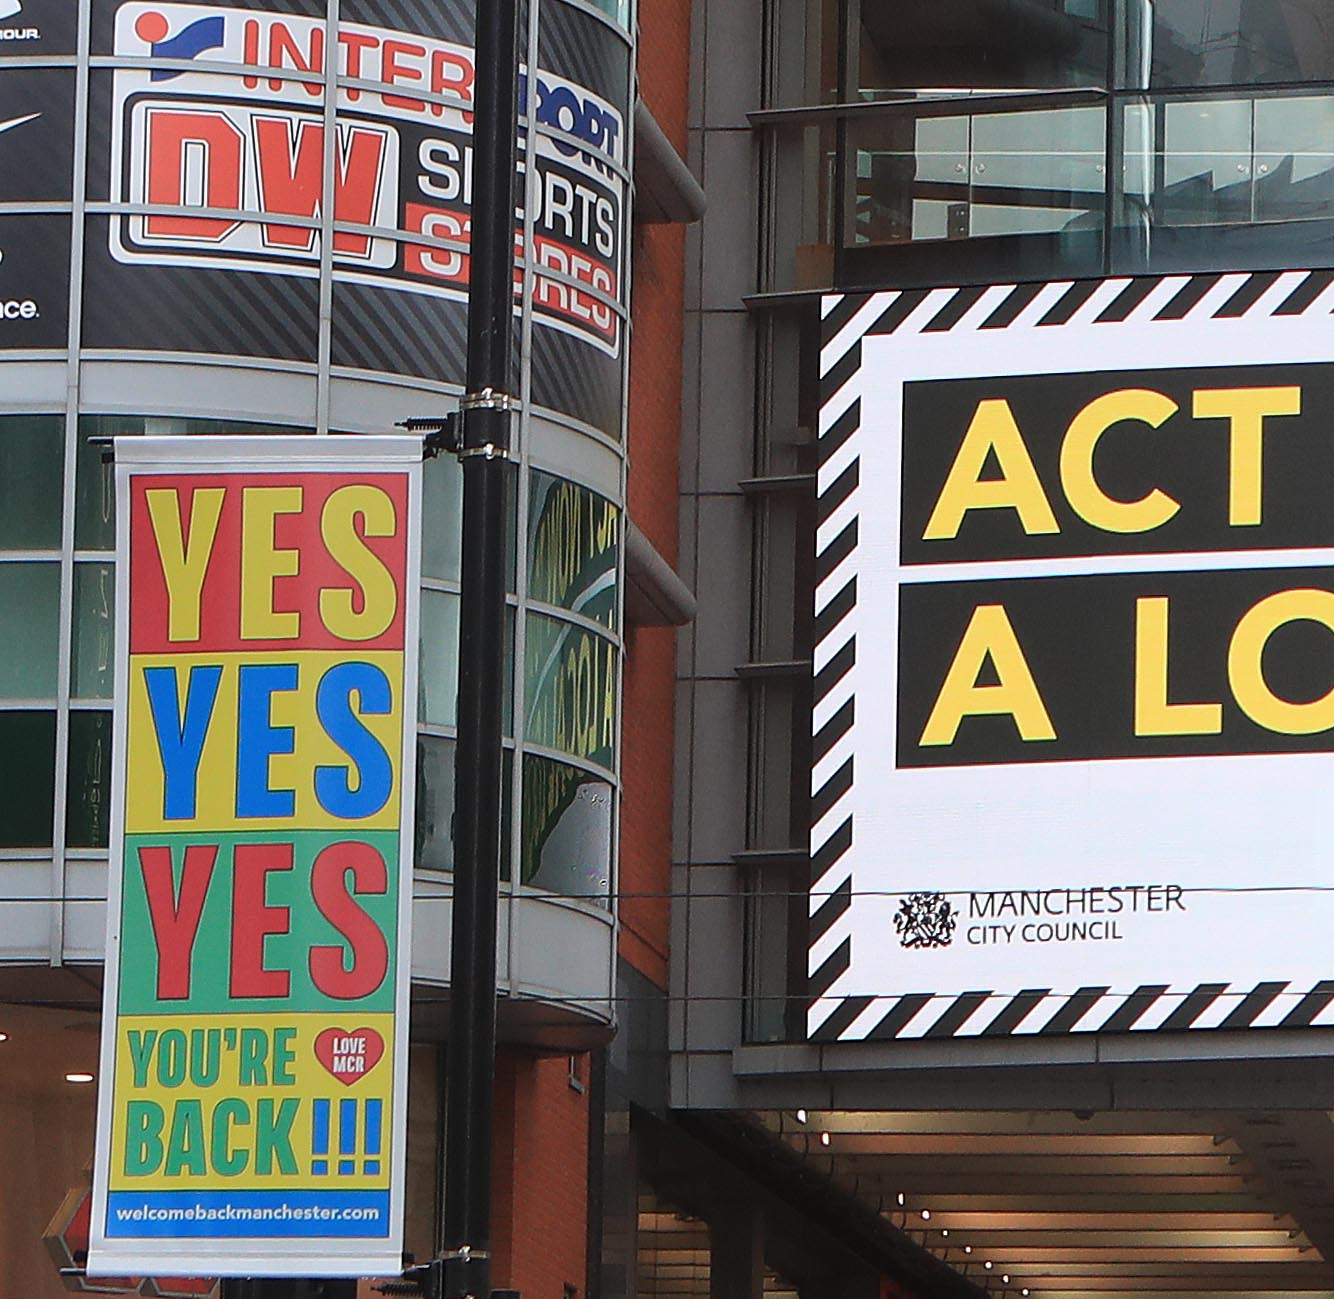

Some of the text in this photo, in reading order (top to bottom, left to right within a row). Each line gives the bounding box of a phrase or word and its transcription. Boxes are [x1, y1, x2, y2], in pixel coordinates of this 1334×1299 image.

[147, 107, 384, 260] DW
[928, 387, 1297, 536] ACT
[145, 485, 397, 642] YES
[924, 608, 1052, 742] A
[143, 661, 393, 820] YES
[138, 840, 389, 1000] YES
[966, 921, 1123, 945] CITY COUNCIL
[969, 885, 1187, 918] MANCHESTER
[126, 1027, 298, 1088] YOU'RE
[332, 1036, 366, 1055] LOVE
[332, 1054, 365, 1075] MCR
[116, 1202, 380, 1222] welcomebackmanchester.com
